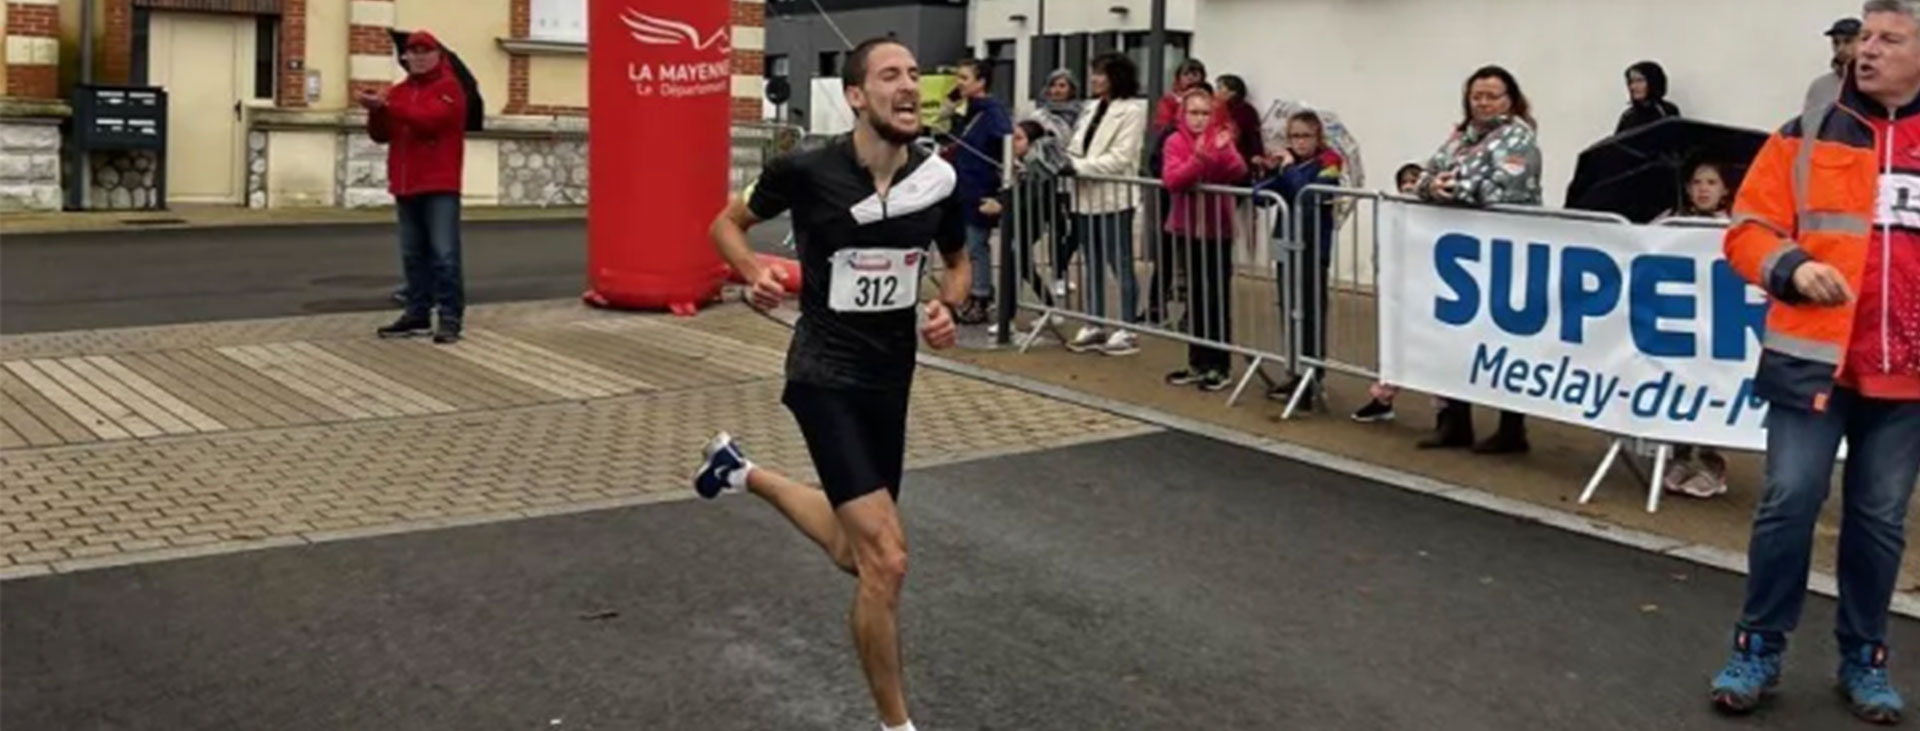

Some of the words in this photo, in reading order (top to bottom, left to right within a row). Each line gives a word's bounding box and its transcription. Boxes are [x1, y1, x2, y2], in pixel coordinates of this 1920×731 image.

[628, 62, 653, 81] LA
[637, 83, 652, 95] Le
[855, 275, 898, 307] 312
